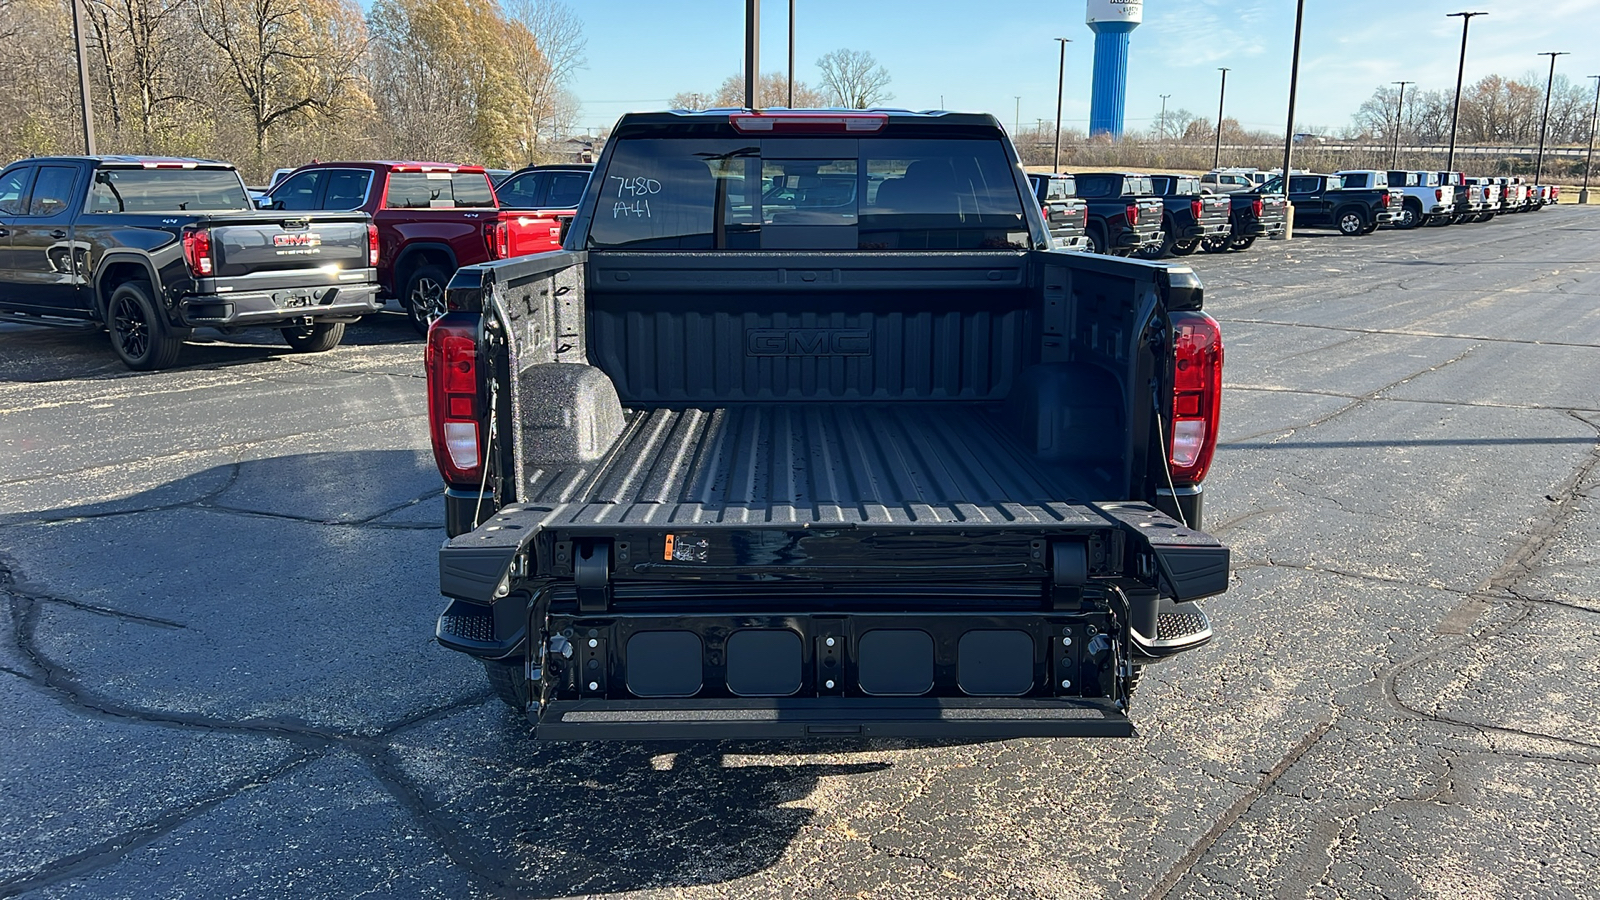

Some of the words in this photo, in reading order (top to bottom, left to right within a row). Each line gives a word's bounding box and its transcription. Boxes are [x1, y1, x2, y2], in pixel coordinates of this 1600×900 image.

[610, 175, 662, 198] 7480
[273, 233, 321, 246] GMC
[748, 330, 871, 355] GMC
